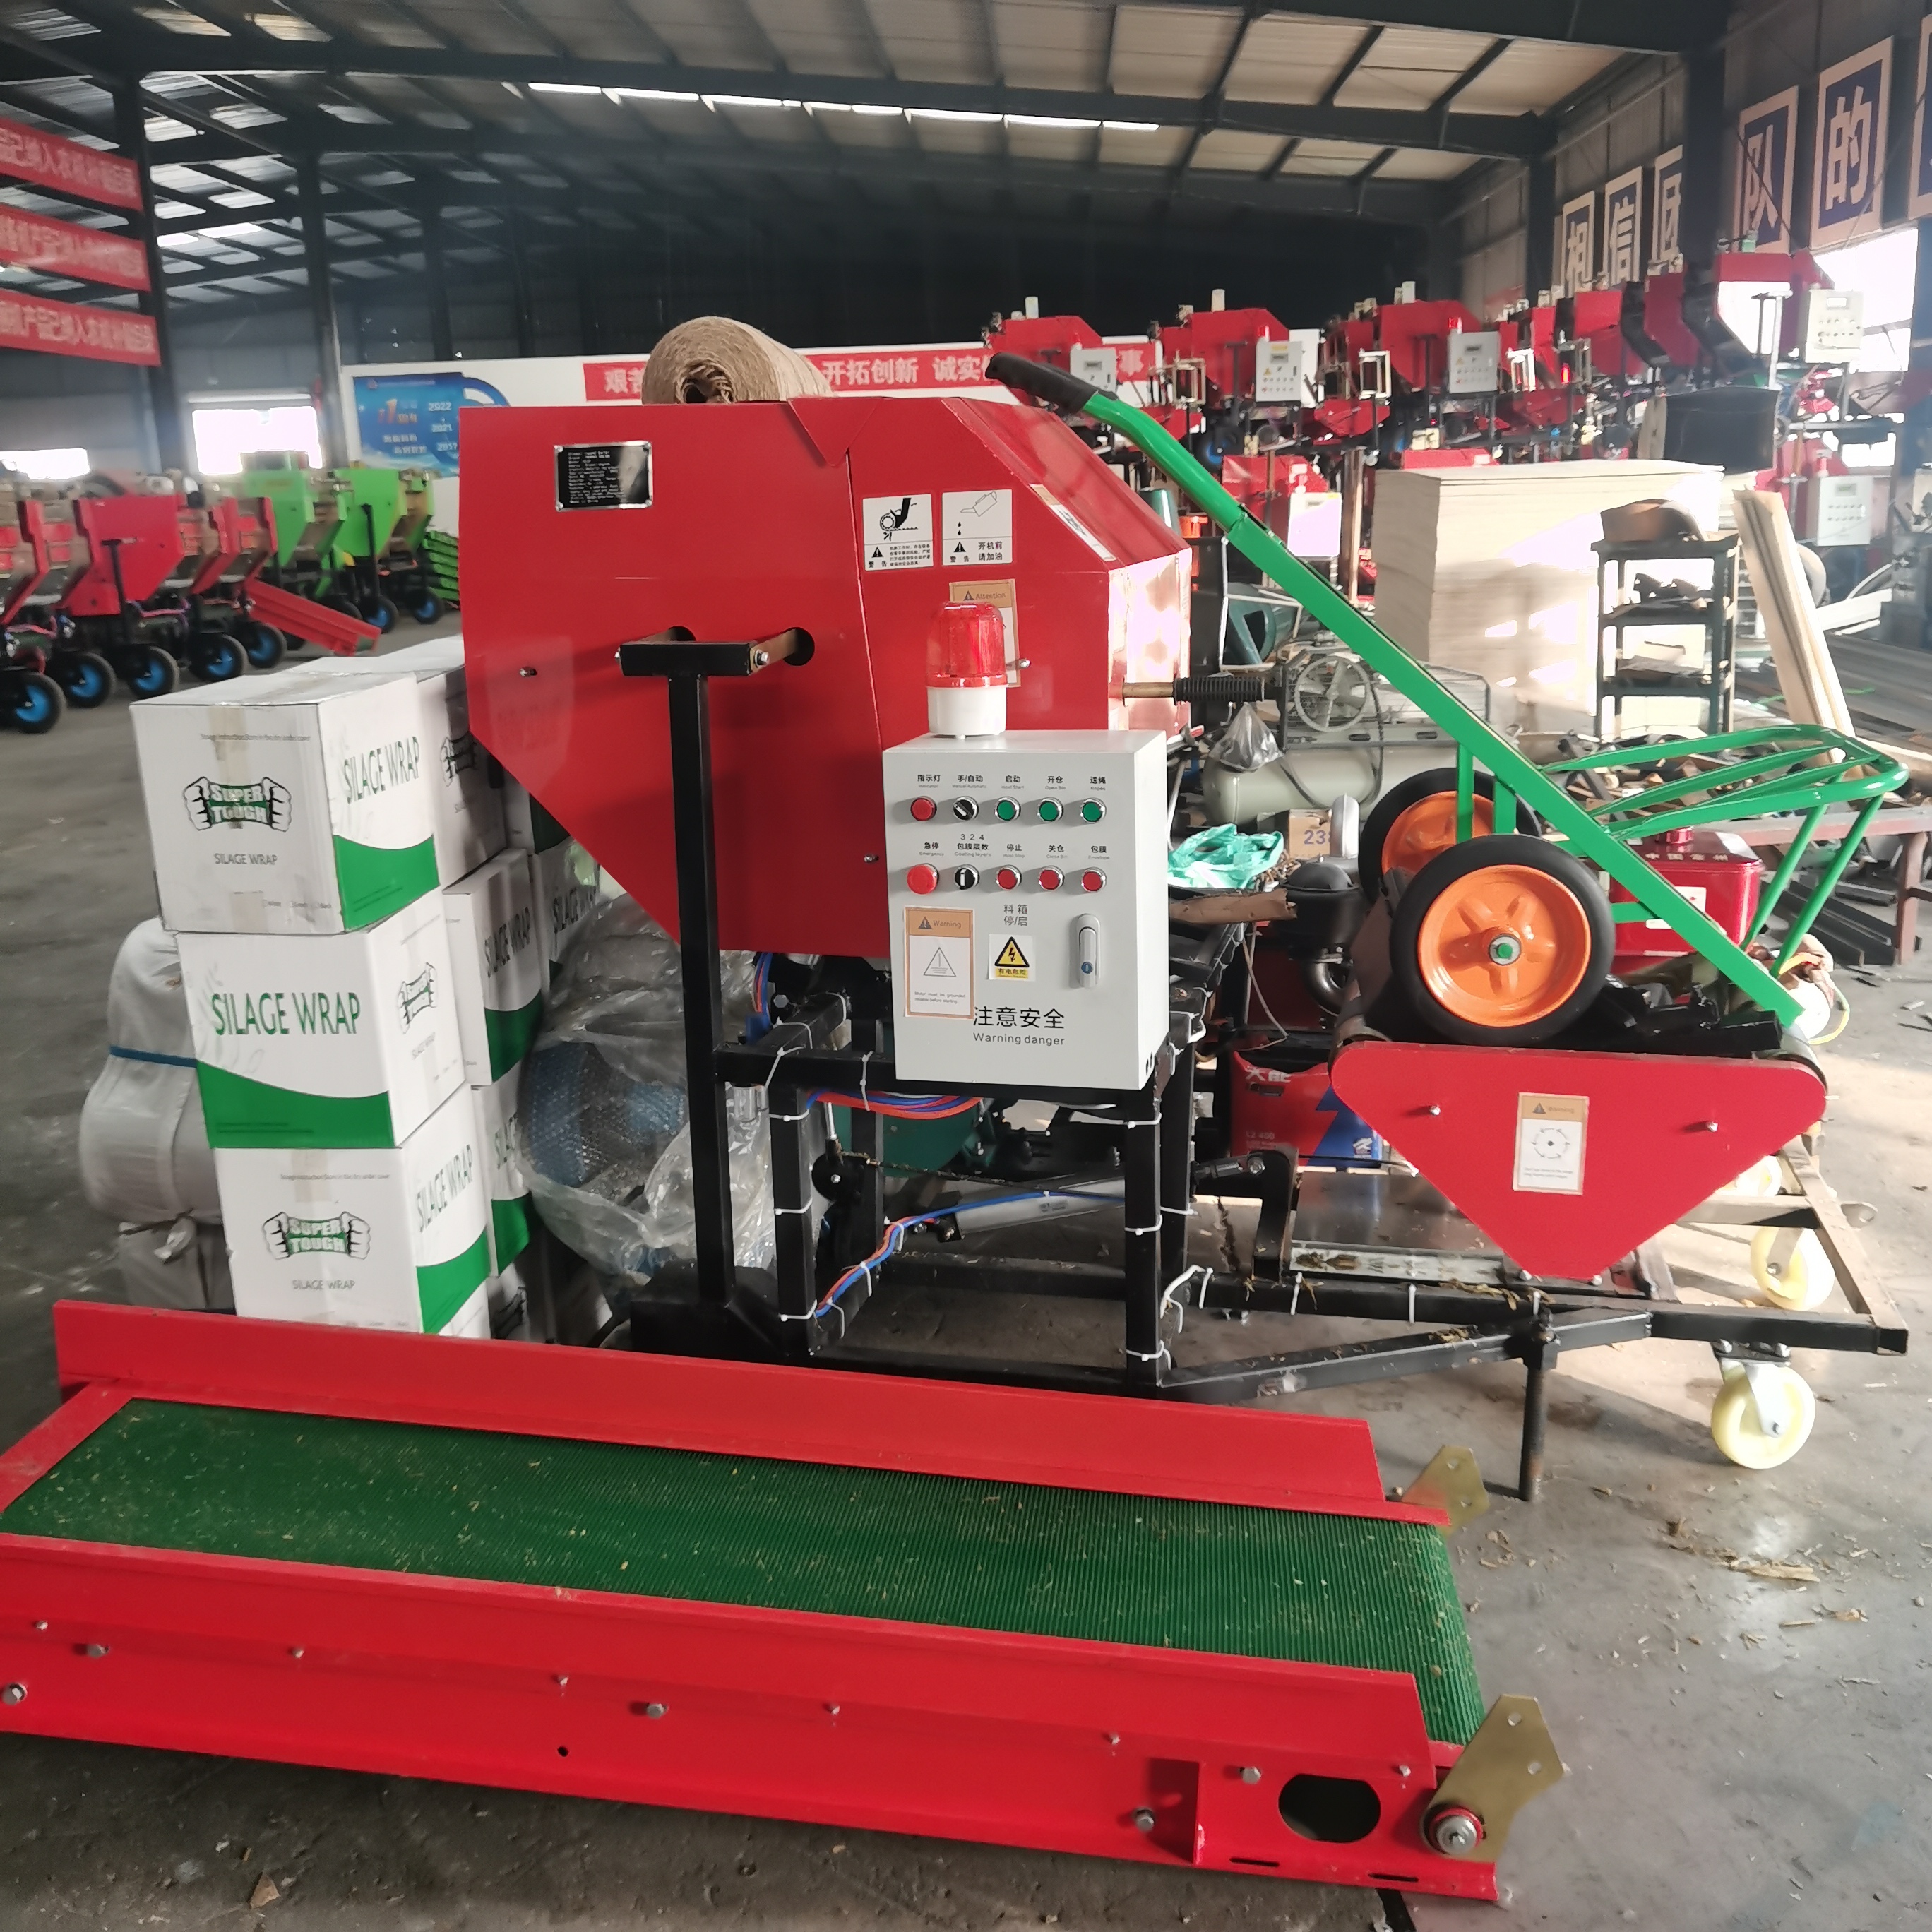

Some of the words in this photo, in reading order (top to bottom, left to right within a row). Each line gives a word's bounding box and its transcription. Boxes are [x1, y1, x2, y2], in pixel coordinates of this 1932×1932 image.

[821, 357, 918, 386] 开拓创新
[931, 355, 990, 381] 诚实
[428, 402, 452, 411] 2022
[978, 541, 1003, 550] 开机前
[978, 552, 1003, 561] 请加油
[344, 747, 386, 804] SILAGE
[384, 736, 419, 787] WRAP
[210, 785, 263, 802] SUPER
[210, 805, 268, 823] TOUGH
[1304, 829, 1330, 845] 23
[214, 853, 247, 864] SILAGE
[248, 854, 278, 865] WRAP
[1003, 904, 1027, 914] 料箱
[933, 920, 962, 929] Warning
[1003, 916, 1028, 926] 停/启
[212, 992, 290, 1035] SILAGE
[291, 992, 361, 1035] WRAP
[973, 1006, 1065, 1029] 注意安全
[973, 1032, 1021, 1045] Warning
[1024, 1034, 1065, 1046] danger
[417, 1169, 448, 1233] SILAGE
[446, 1144, 472, 1200] WRAP
[288, 1220, 342, 1236] SUPER
[290, 1237, 345, 1253] TOUGH
[292, 1280, 323, 1290] SILAGE
[328, 1280, 355, 1289] WRAP
